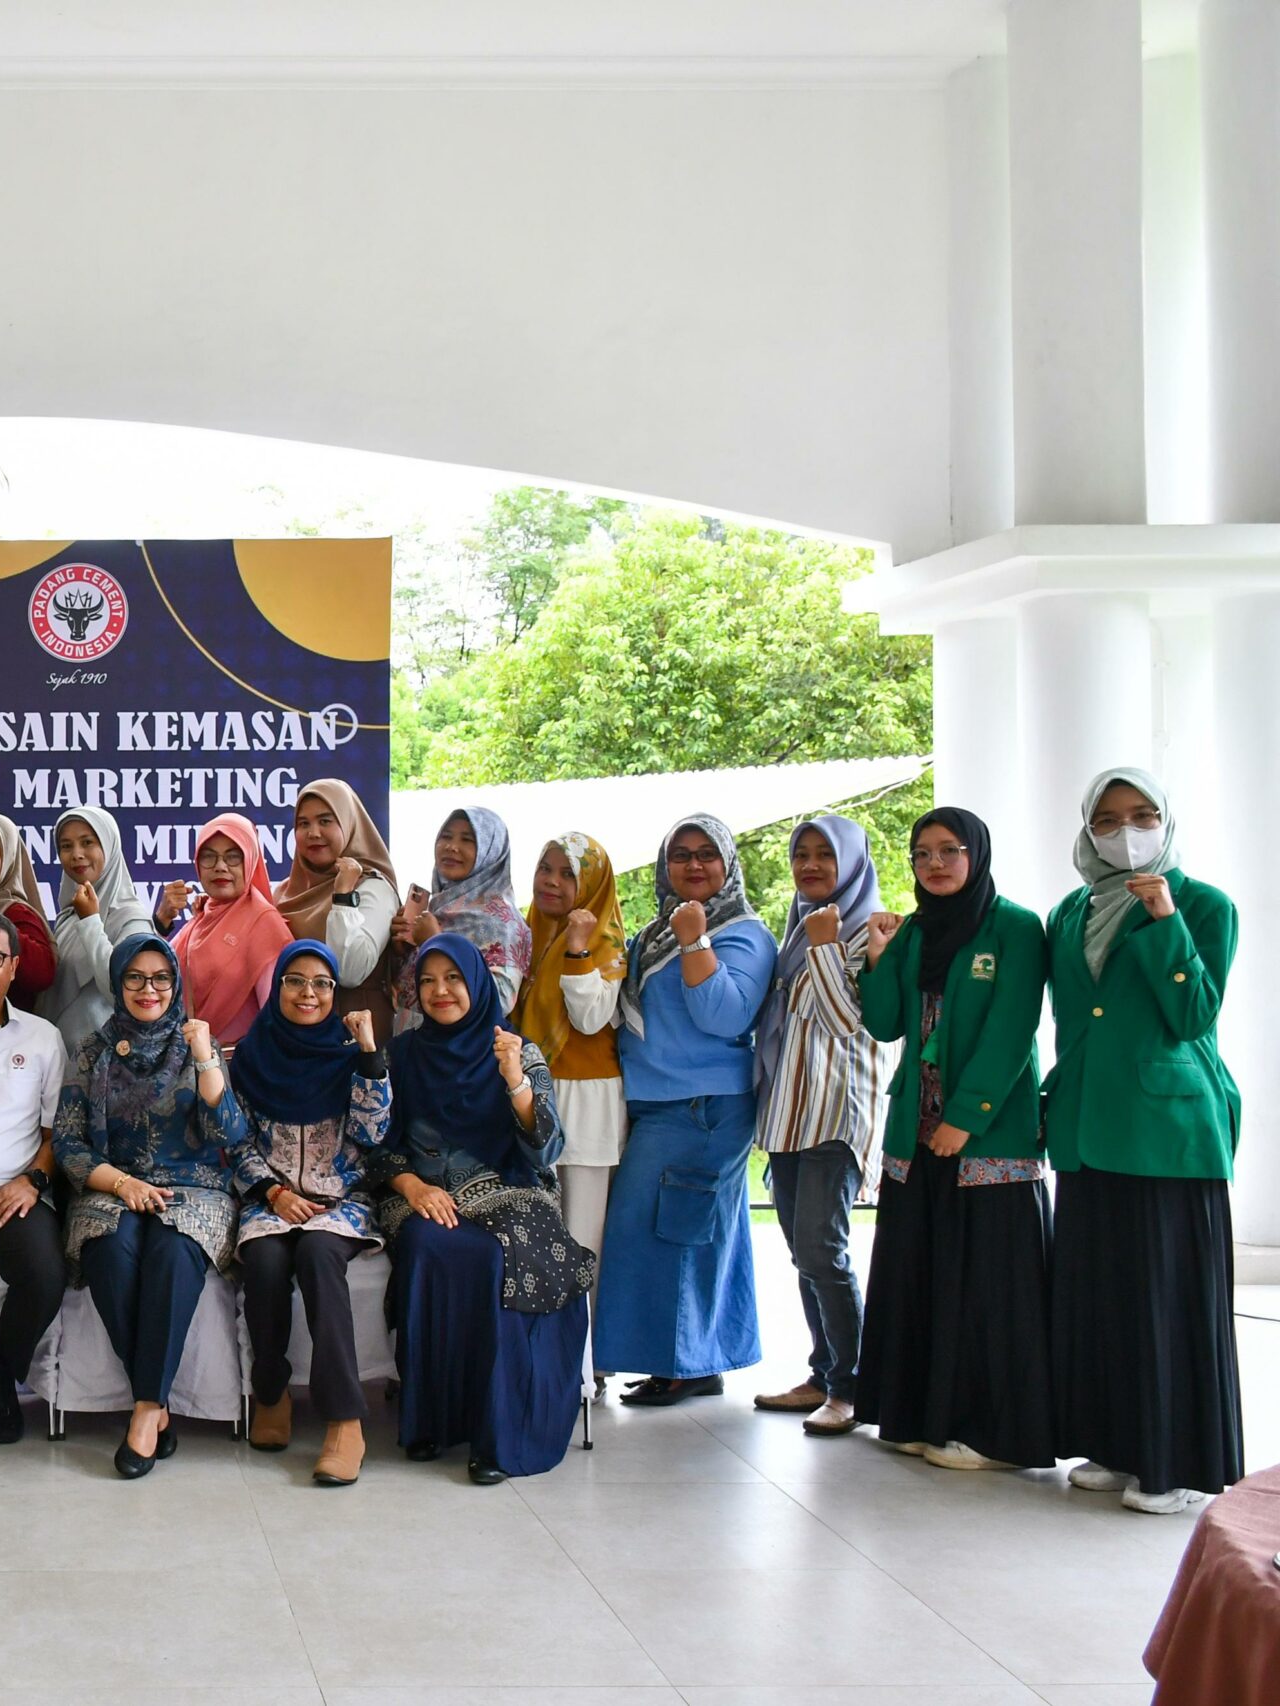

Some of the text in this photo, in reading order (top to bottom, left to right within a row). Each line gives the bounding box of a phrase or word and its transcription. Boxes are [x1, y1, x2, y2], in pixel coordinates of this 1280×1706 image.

[33, 568, 124, 619] PADANG CEMENT
[40, 630, 117, 657] INDONESIA
[46, 669, 108, 691] Sejak 1910
[116, 710, 339, 752] KEMASAN
[12, 766, 301, 809] MARKETING
